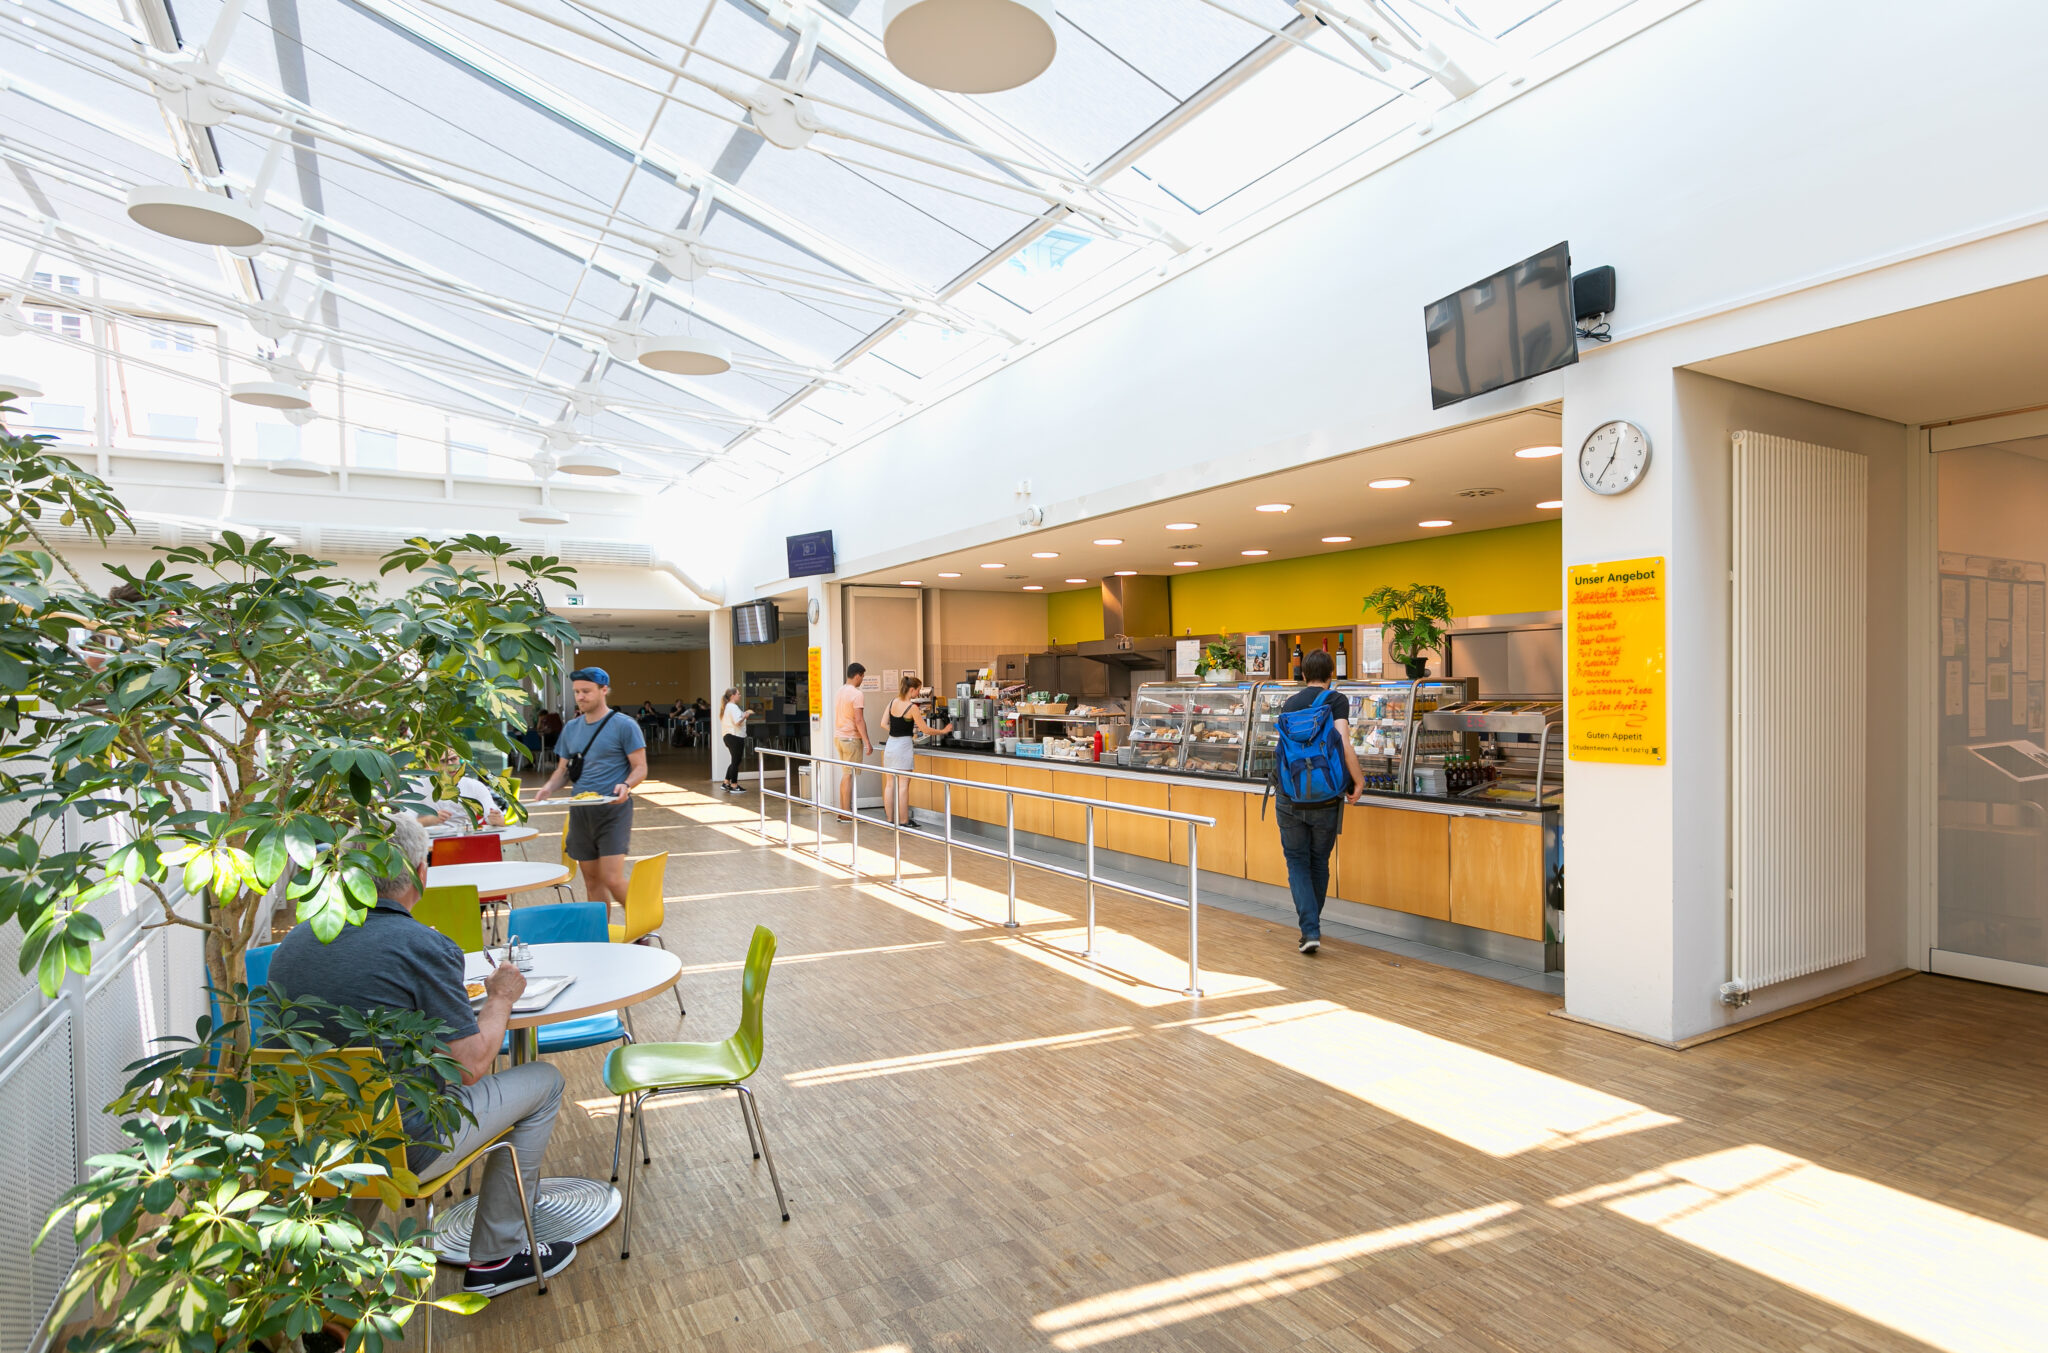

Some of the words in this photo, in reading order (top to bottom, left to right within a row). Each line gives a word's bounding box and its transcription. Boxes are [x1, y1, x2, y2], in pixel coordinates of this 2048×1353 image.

[1575, 575, 1604, 585] Unser
[1607, 570, 1655, 583] Angebot
[1586, 731, 1610, 740] Guten
[1612, 732, 1642, 741] Appetit
[1573, 744, 1618, 752] Studentenwerk
[1622, 746, 1649, 754] Leipzig
